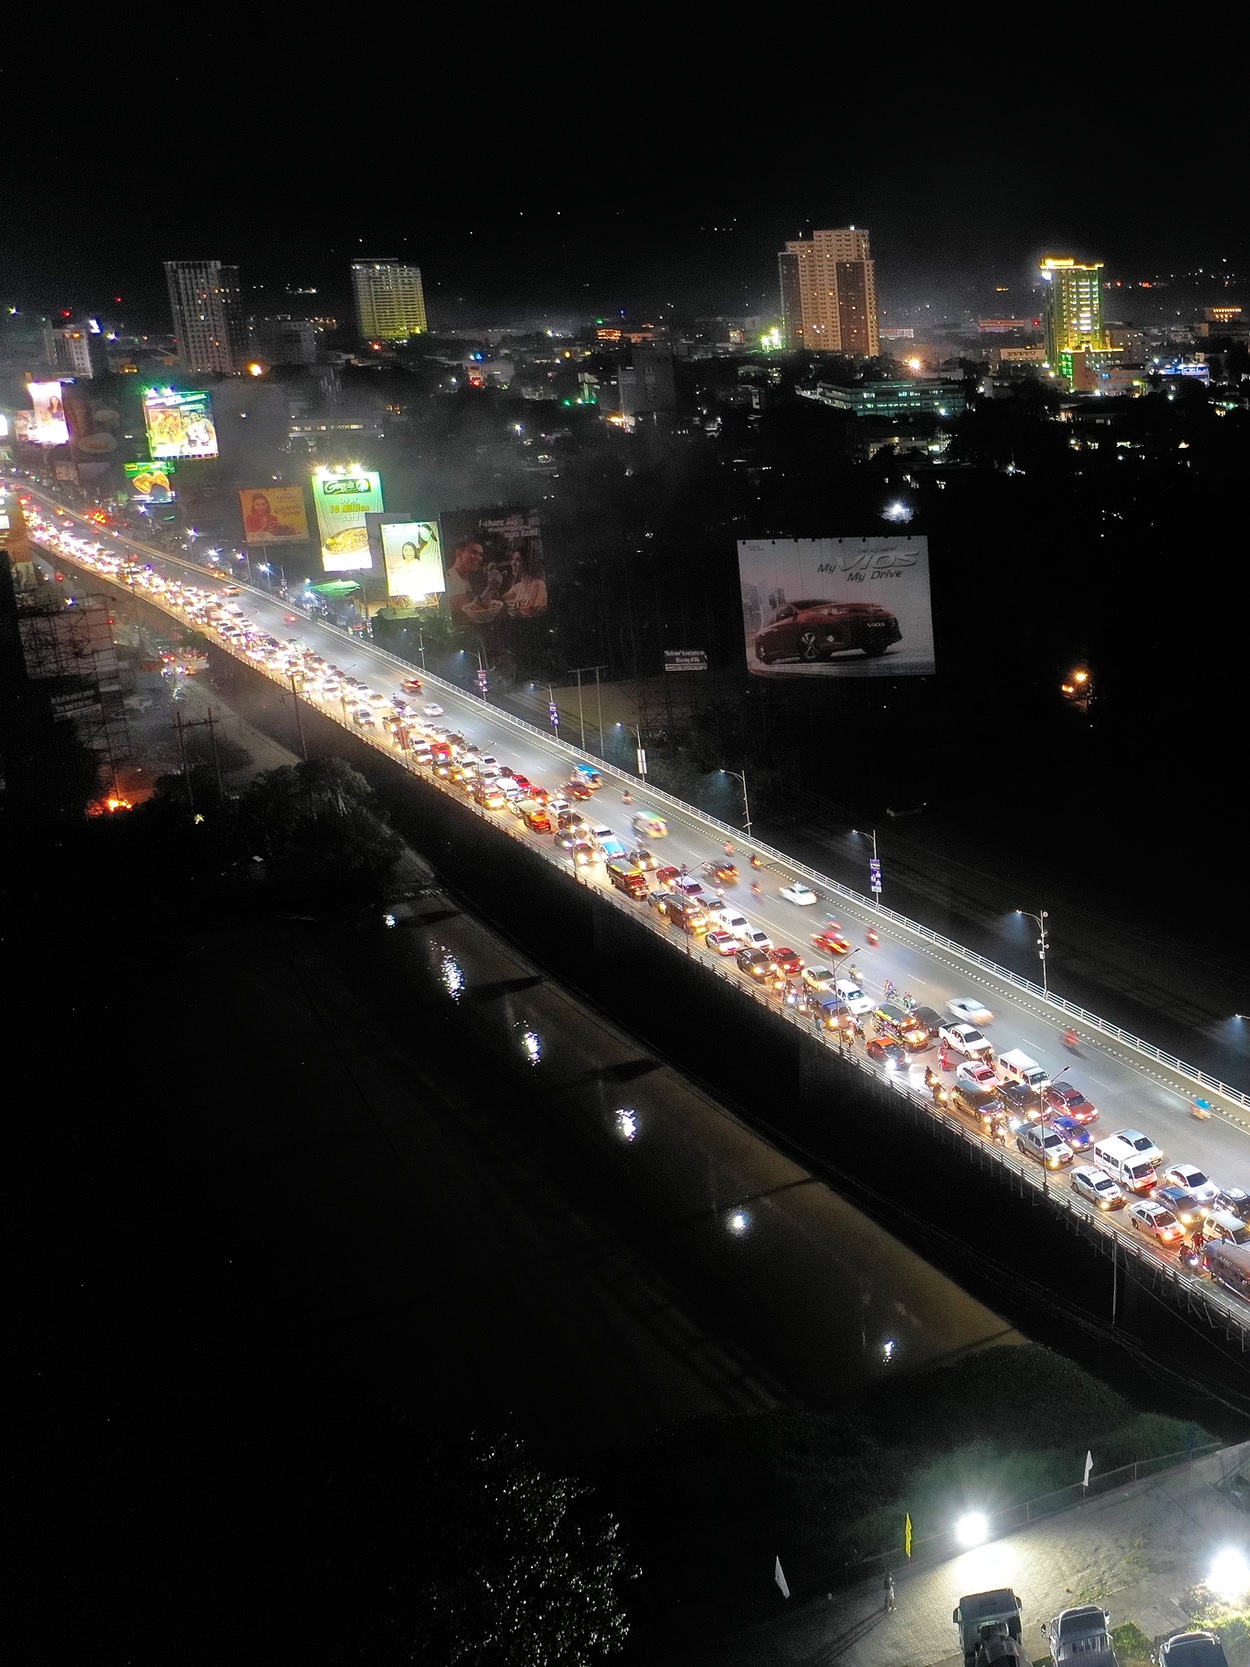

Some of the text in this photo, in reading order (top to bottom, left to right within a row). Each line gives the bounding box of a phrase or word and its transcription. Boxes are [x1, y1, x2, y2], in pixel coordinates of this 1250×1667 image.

[330, 503, 370, 514] 10 Million
[817, 551, 920, 574] My VIOS
[847, 570, 903, 583] My Drive
